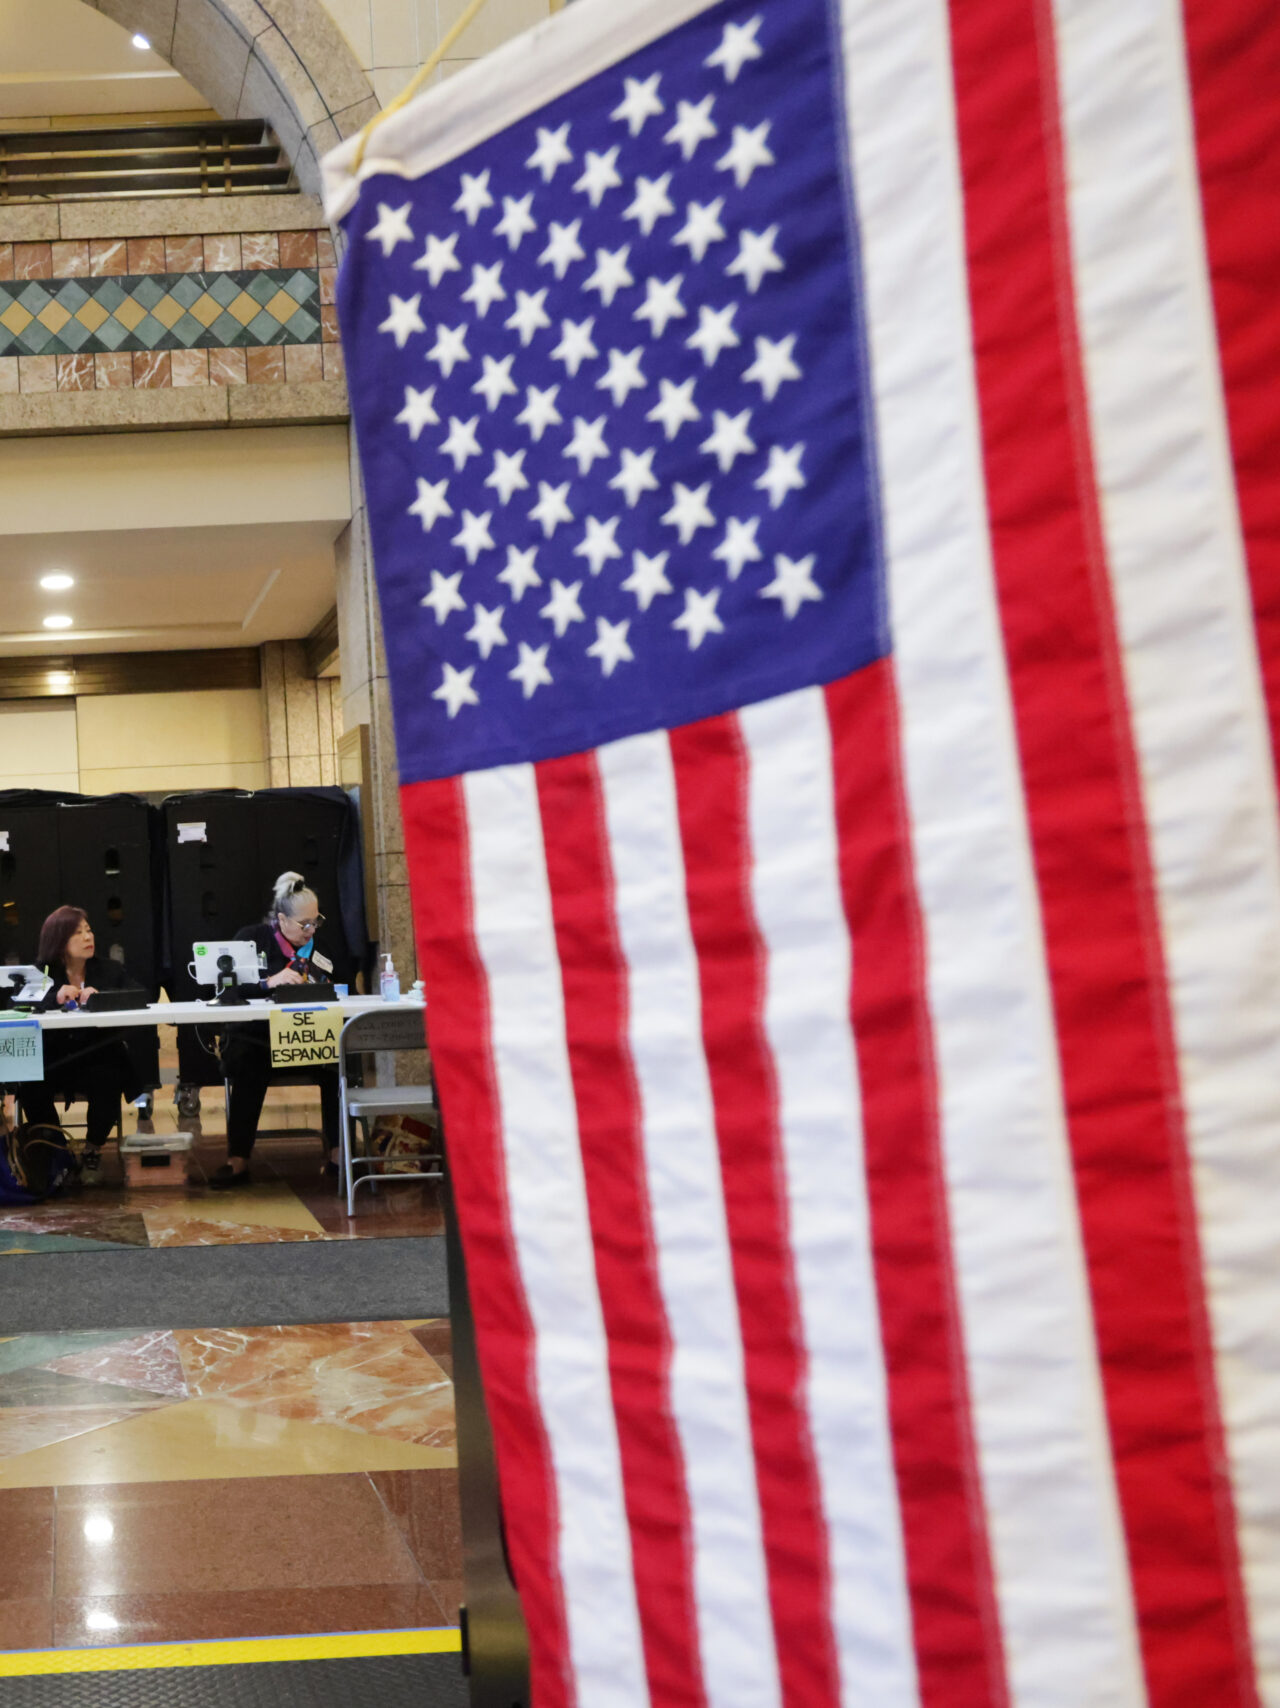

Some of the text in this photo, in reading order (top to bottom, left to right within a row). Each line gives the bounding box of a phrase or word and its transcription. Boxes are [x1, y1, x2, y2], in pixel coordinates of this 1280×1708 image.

[293, 1012, 315, 1026] SE
[278, 1028, 335, 1044] HABLA
[272, 1046, 339, 1063] ESPANOL
